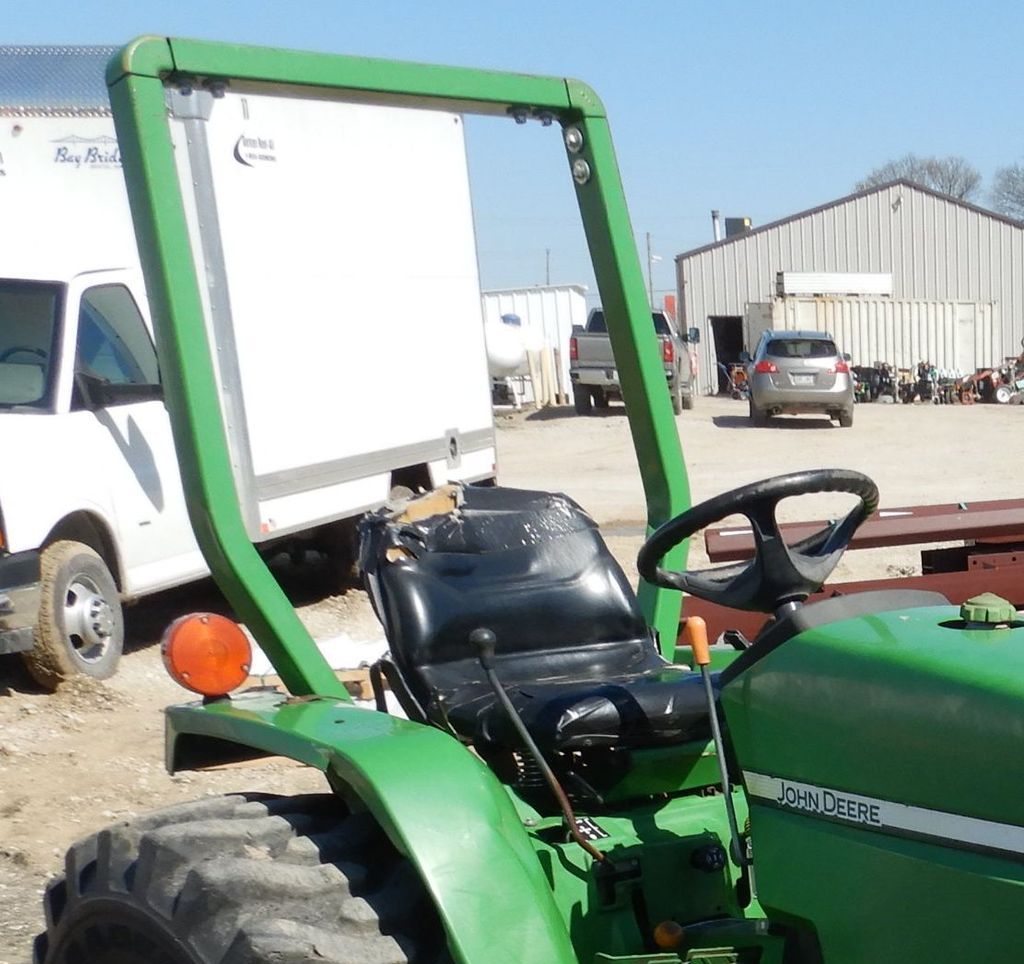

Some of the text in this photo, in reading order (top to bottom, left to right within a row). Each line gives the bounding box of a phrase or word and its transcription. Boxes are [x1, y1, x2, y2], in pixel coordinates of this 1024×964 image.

[54, 147, 80, 168] Bay
[777, 782, 880, 823] JOHN DEERE
